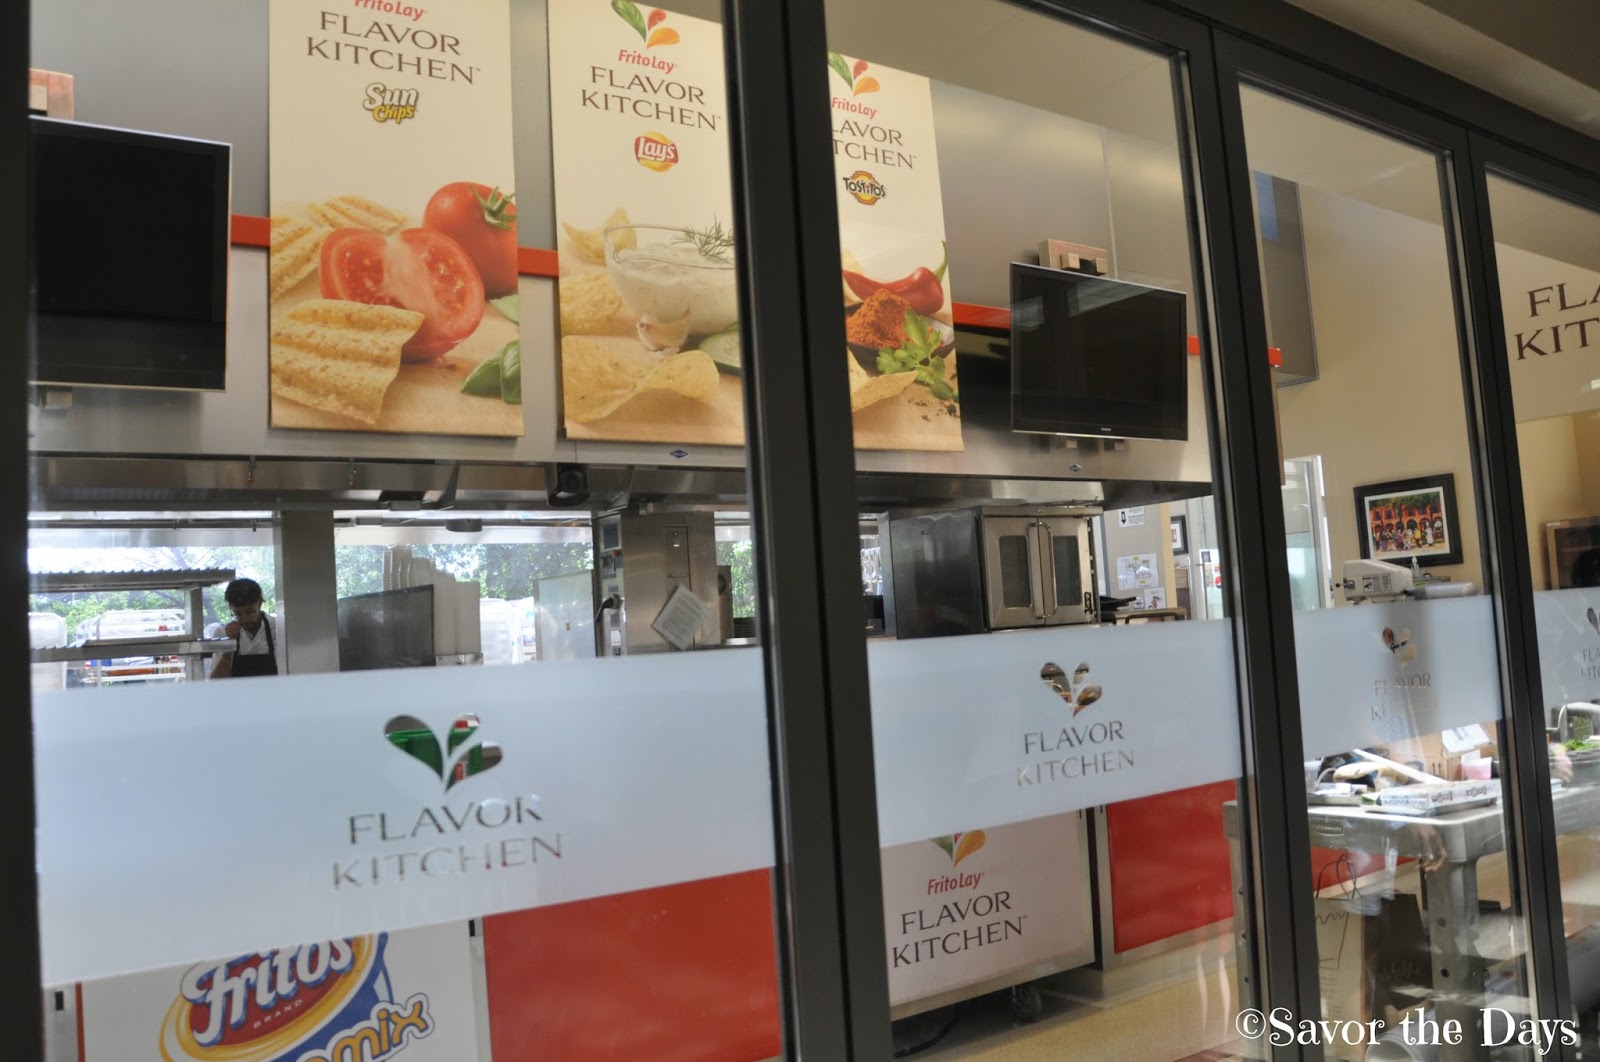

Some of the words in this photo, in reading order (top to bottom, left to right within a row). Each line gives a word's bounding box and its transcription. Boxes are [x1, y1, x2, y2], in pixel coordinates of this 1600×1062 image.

[320, 11, 461, 56] FLAVOR
[306, 36, 474, 85] KITCHEN
[363, 82, 419, 111] Sun
[591, 66, 706, 106] FLAVOR
[372, 105, 415, 124] Chips
[581, 89, 717, 131] KITCHEN
[832, 119, 904, 146] AVOR
[832, 138, 914, 169] TCHEN
[1024, 720, 1124, 754] FLAVOR
[1016, 749, 1135, 788] KITCHEN
[348, 794, 543, 845] FLAVOR
[332, 833, 562, 891] KITCHEN
[901, 890, 1012, 935] FLAVOR
[892, 916, 1023, 968] KITCHEN
[180, 938, 356, 1047] Fritos
[253, 998, 304, 1030] BRAND
